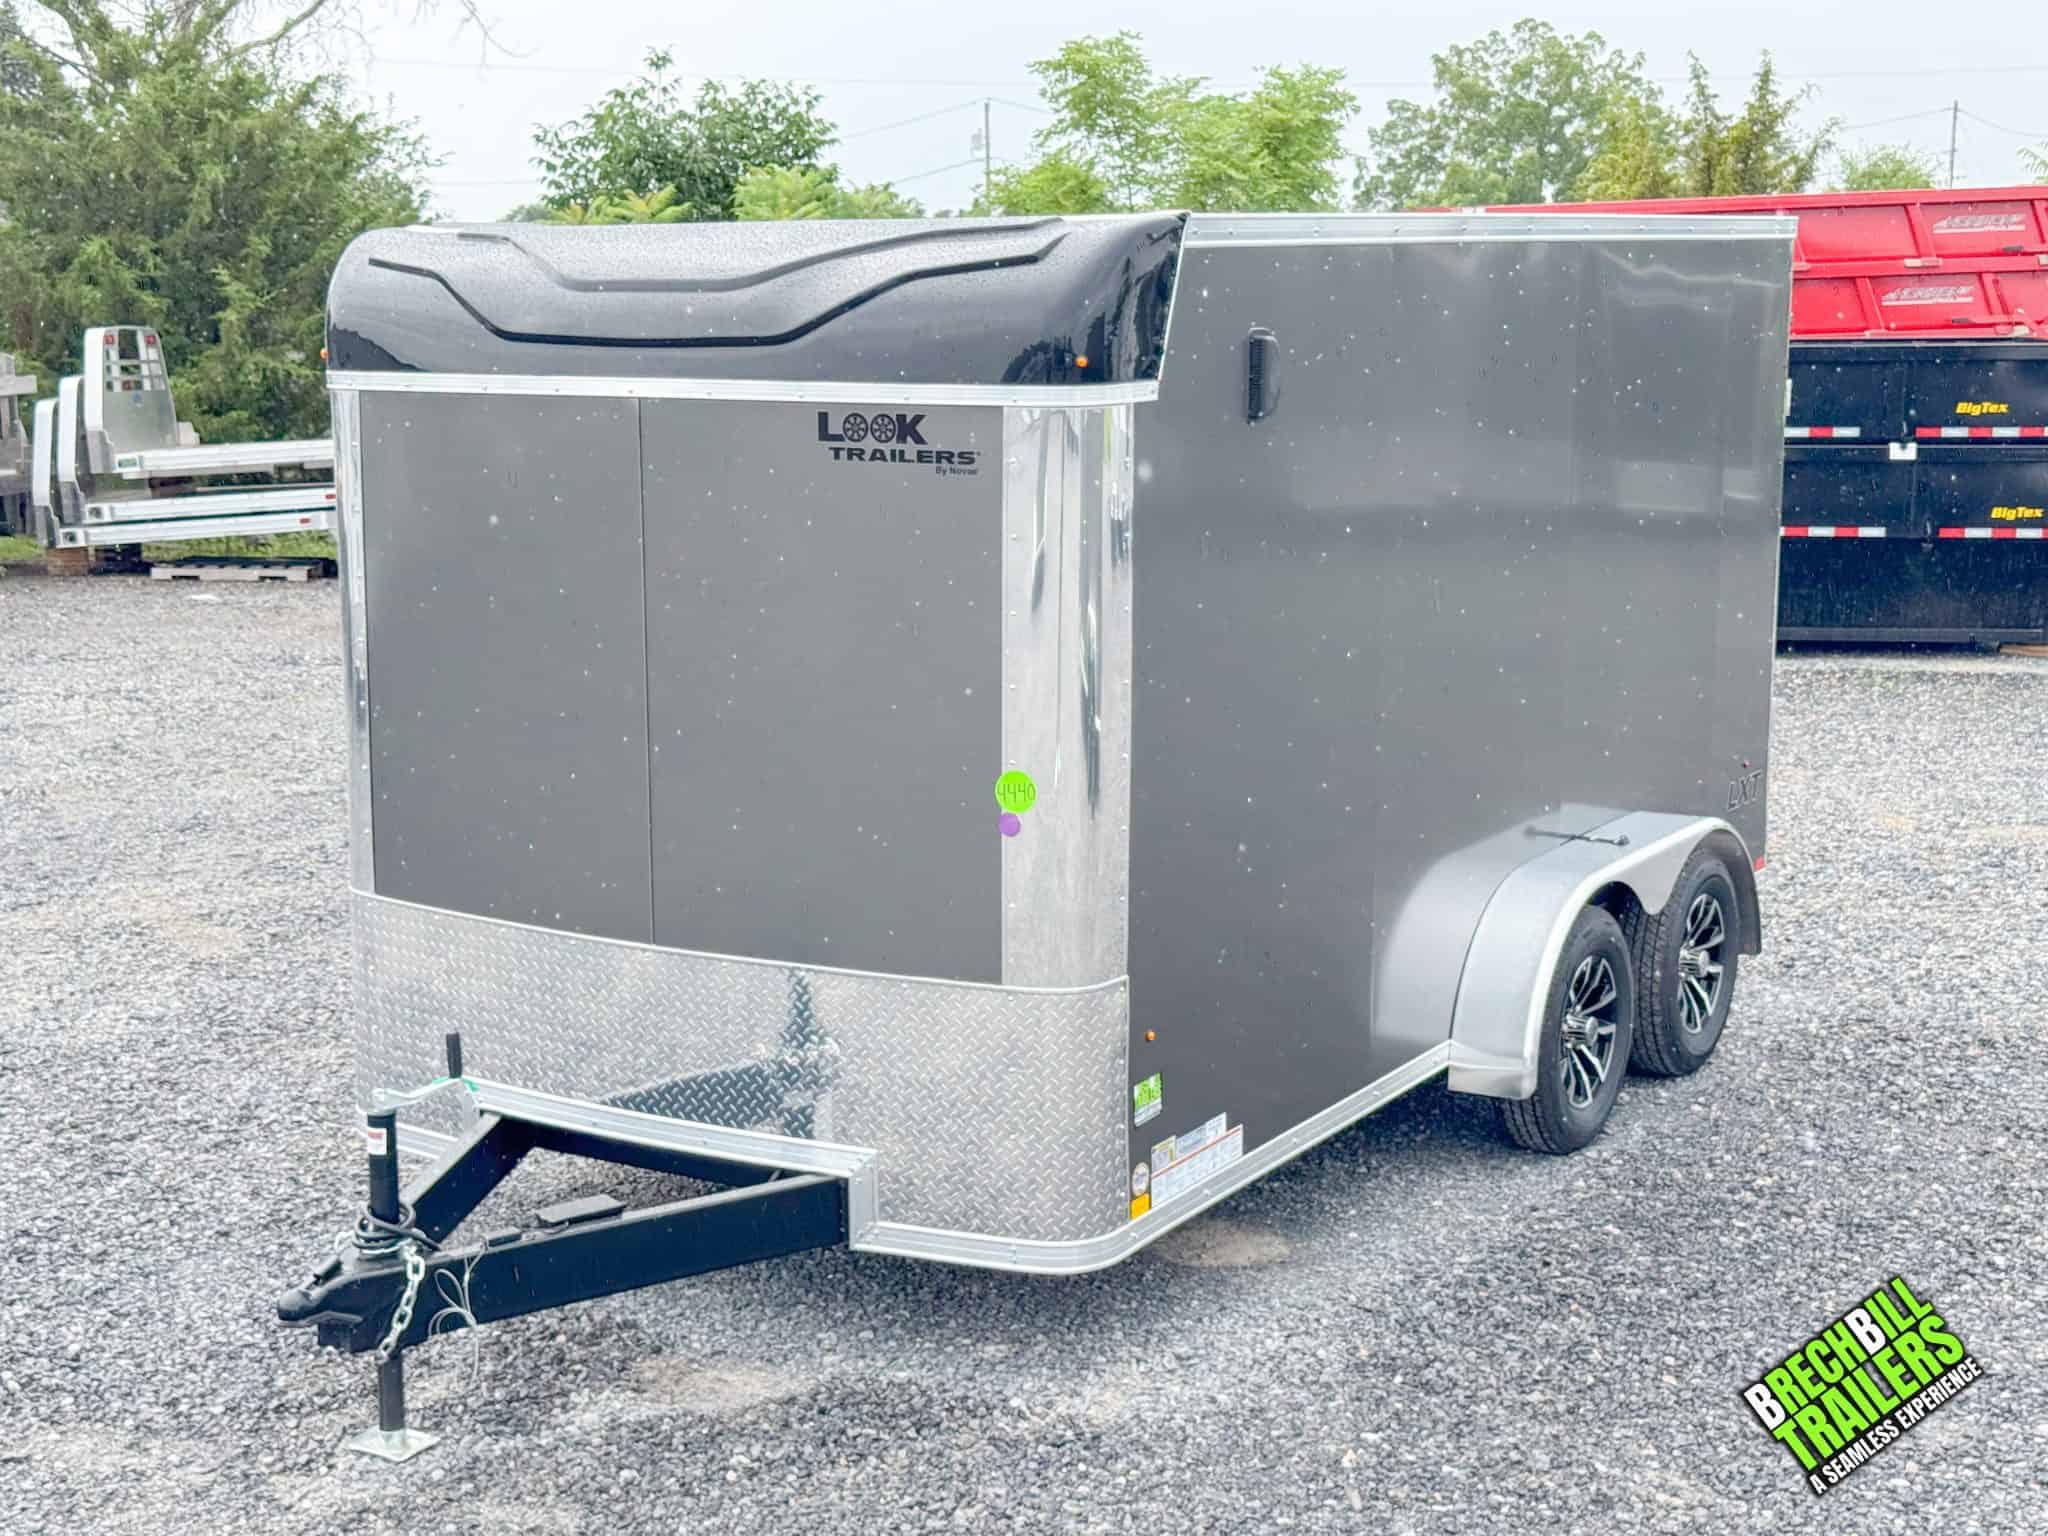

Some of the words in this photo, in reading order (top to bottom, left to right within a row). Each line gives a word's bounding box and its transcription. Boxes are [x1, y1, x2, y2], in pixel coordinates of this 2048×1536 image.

[1955, 401, 2009, 416] BigTex
[817, 411, 928, 445] LOOK
[828, 447, 977, 465] TRAILERS
[1991, 506, 2044, 521] BigTex
[997, 782, 1036, 802] 4440
